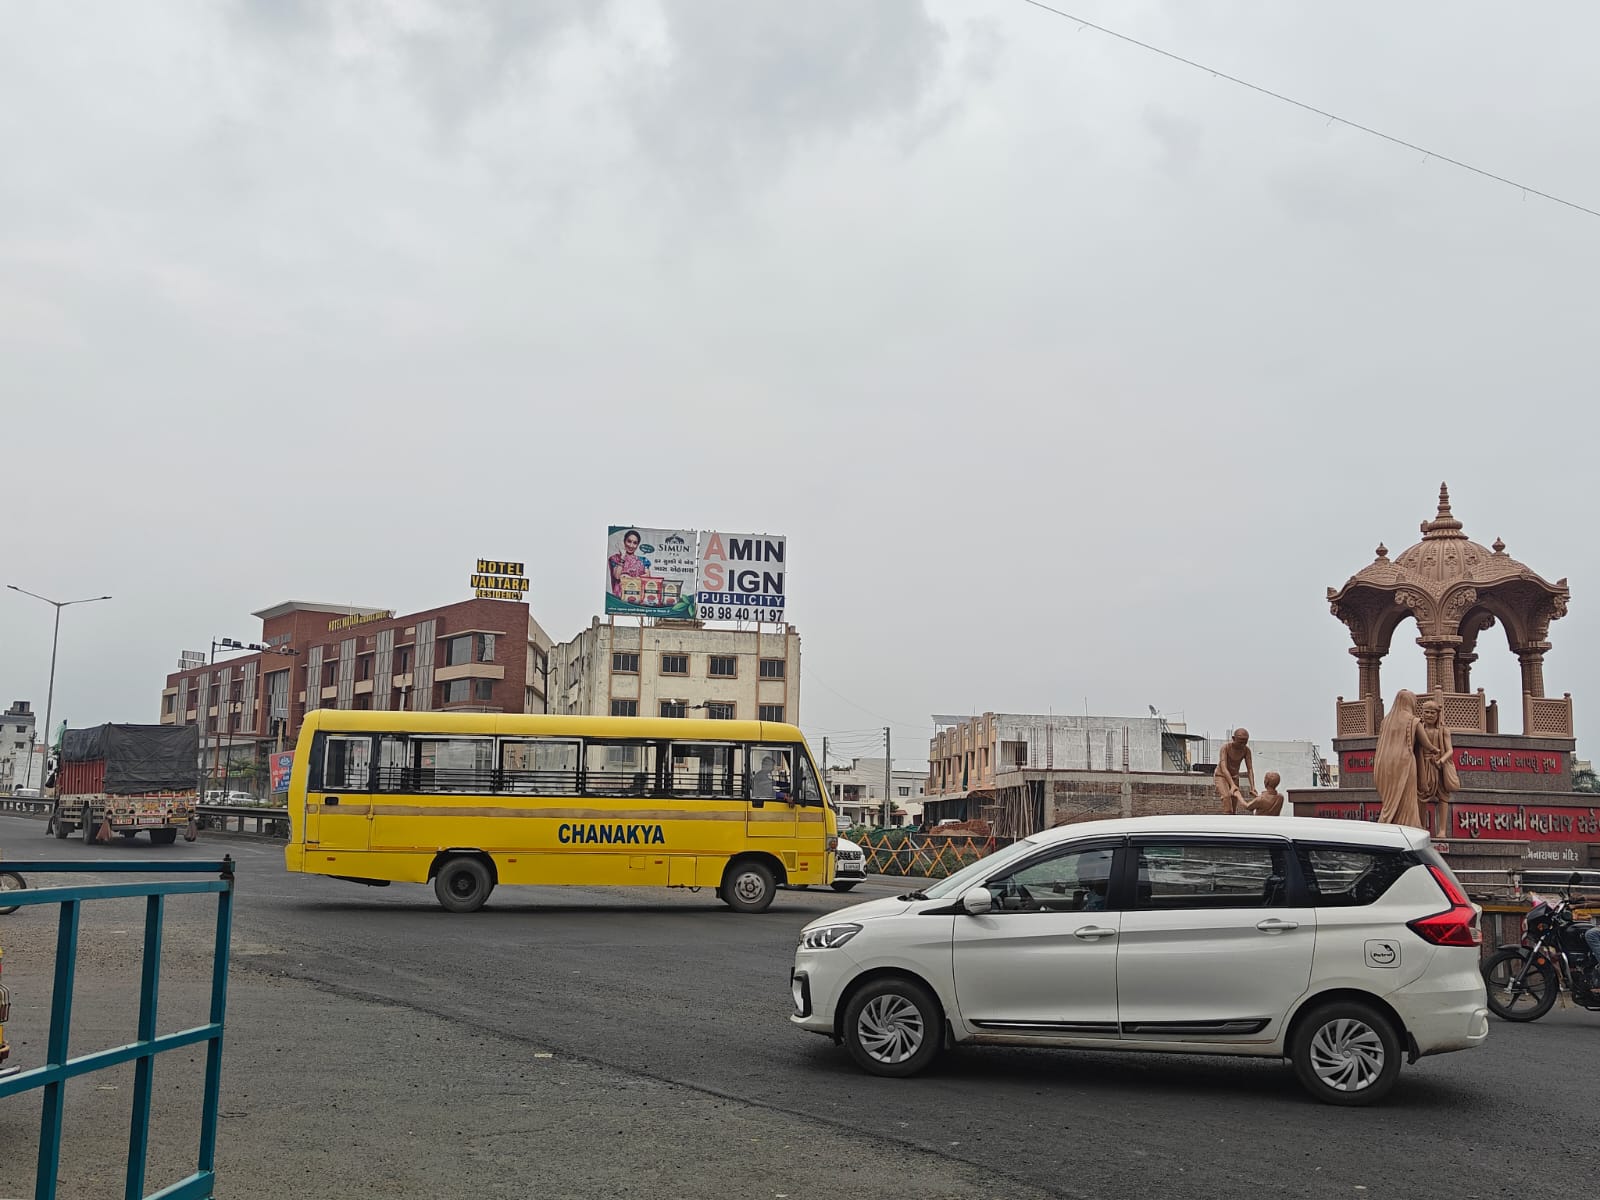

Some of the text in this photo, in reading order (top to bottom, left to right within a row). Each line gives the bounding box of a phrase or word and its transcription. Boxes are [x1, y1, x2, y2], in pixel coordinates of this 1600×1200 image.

[658, 543, 690, 552] SIMUN
[703, 532, 784, 562] AMIN
[478, 561, 522, 575] HOTEL
[472, 576, 528, 590] VANTARA
[703, 563, 783, 594] SIGN
[475, 589, 521, 600] RESIDENCY
[701, 593, 782, 606] PUBLICITY
[700, 606, 783, 622] 98 98 40 11 97
[1458, 806, 1600, 838] પ્રમુખ સ્વામી મહારાજ સર્ક
[558, 823, 665, 844] CHANAKYA
